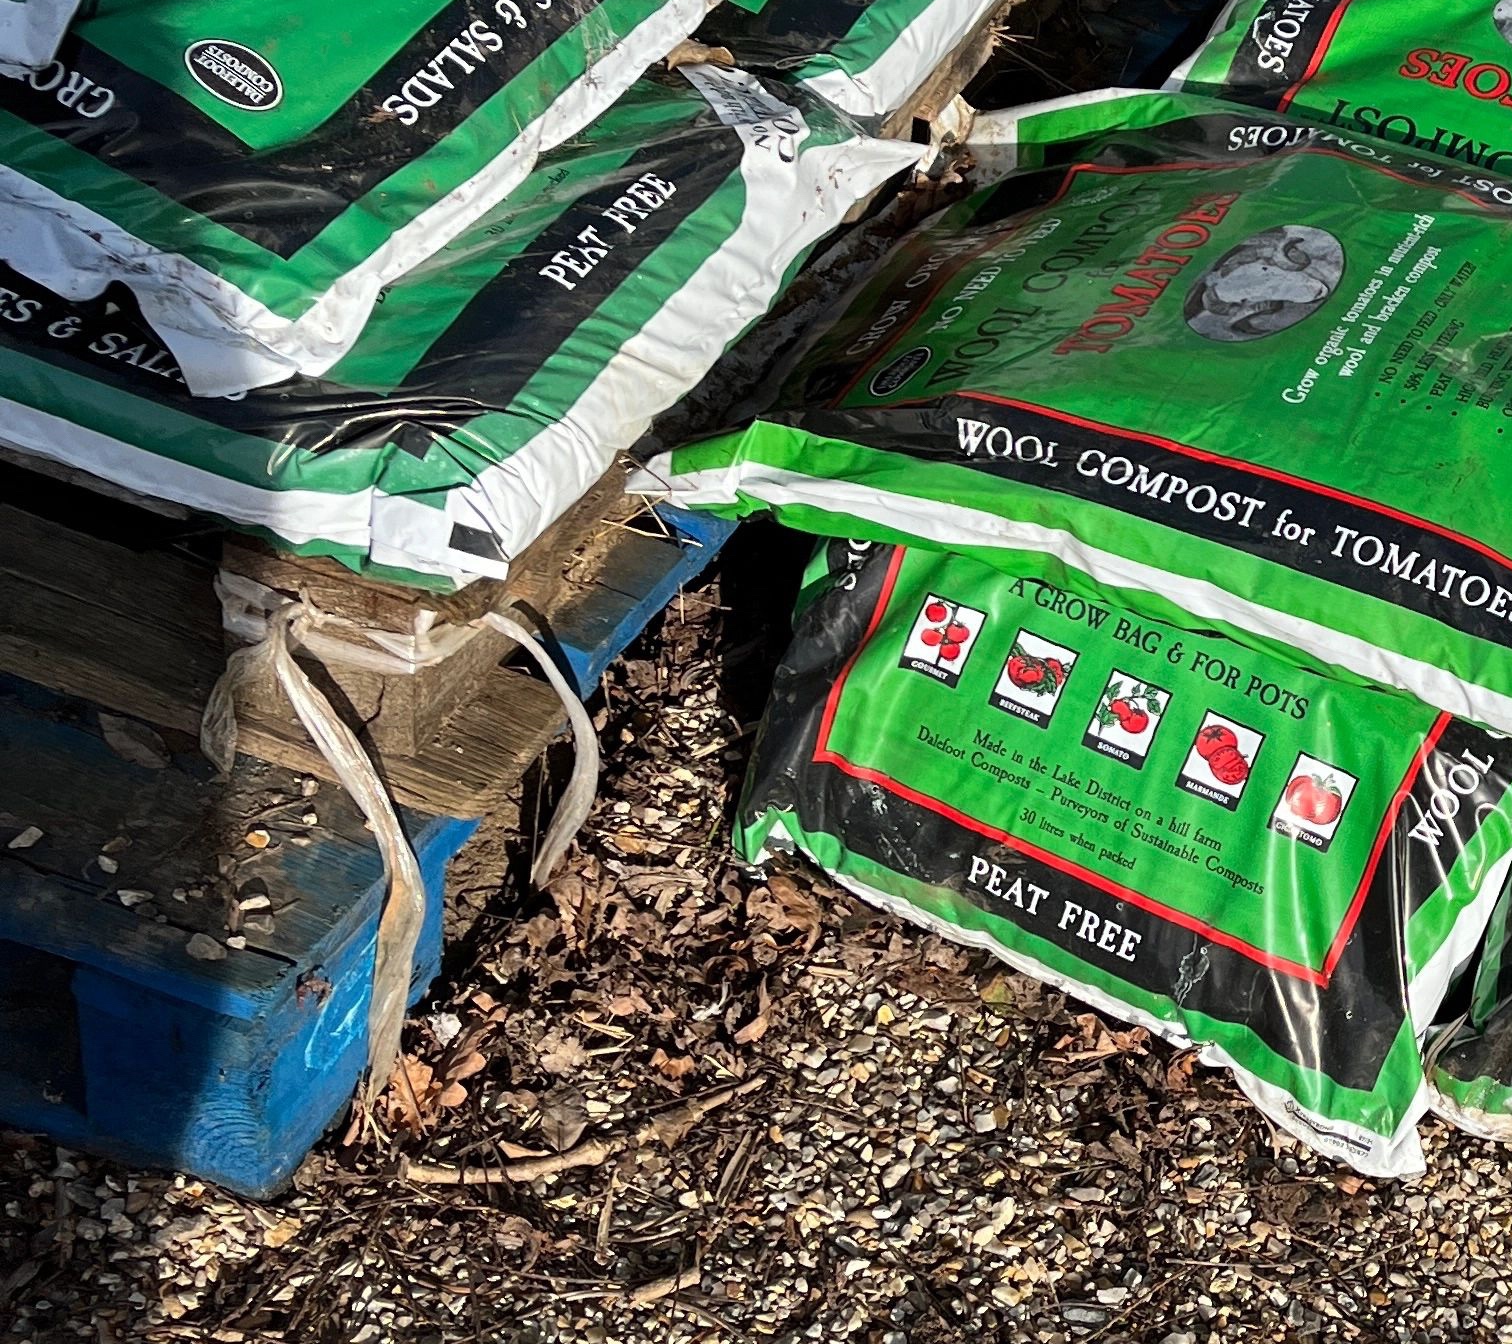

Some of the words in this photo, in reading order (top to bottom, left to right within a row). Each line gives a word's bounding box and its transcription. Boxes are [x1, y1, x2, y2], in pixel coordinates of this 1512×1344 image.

[206, 44, 274, 94] COMPOSTS
[382, 20, 503, 126] SALADS
[538, 226, 608, 290] PEAT
[601, 172, 677, 235] FREE
[1405, 245, 1442, 283] compost
[925, 306, 1042, 388] WOOL
[926, 305, 963, 335] NO
[952, 265, 1001, 303] NEED
[1281, 367, 1320, 403] Grow
[1314, 325, 1349, 366] organic
[1341, 278, 1384, 323] tomatoes
[1374, 264, 1394, 277] in
[1388, 213, 1436, 264] nutrient-rich
[1360, 323, 1382, 344] and
[1368, 285, 1411, 322] bracken
[1338, 346, 1367, 377] wool
[956, 416, 1059, 468] WOOL
[1076, 448, 1266, 528] COMPOST
[1271, 508, 1316, 548] for
[1008, 578, 1025, 598] A
[1034, 585, 1112, 630] GROW
[1112, 617, 1161, 654] BAG
[1167, 641, 1185, 664] &
[1189, 651, 1241, 689] FOR
[1244, 675, 1309, 720] POTS
[916, 725, 965, 759] Dalefoot
[970, 752, 1030, 790] Composts
[1050, 787, 1109, 824] Purveyors
[1114, 818, 1128, 833] of
[1131, 823, 1199, 864] Sustainable
[1206, 856, 1265, 895] Composts
[973, 729, 1008, 755] Made
[1012, 749, 1023, 764] in
[1029, 755, 1048, 775] the
[1052, 765, 1081, 789] Lake
[1085, 780, 1132, 812] District
[1135, 808, 1151, 820] on
[1156, 817, 1163, 826] a
[1168, 816, 1189, 837] hill
[1194, 829, 1222, 852] farm
[1019, 808, 1035, 824] 30
[1039, 817, 1064, 838] litres
[1069, 832, 1095, 852] when
[1099, 847, 1136, 870] packed
[1407, 748, 1494, 846] WOOL
[968, 855, 1050, 916] PEAT
[1057, 900, 1143, 962] FREE
